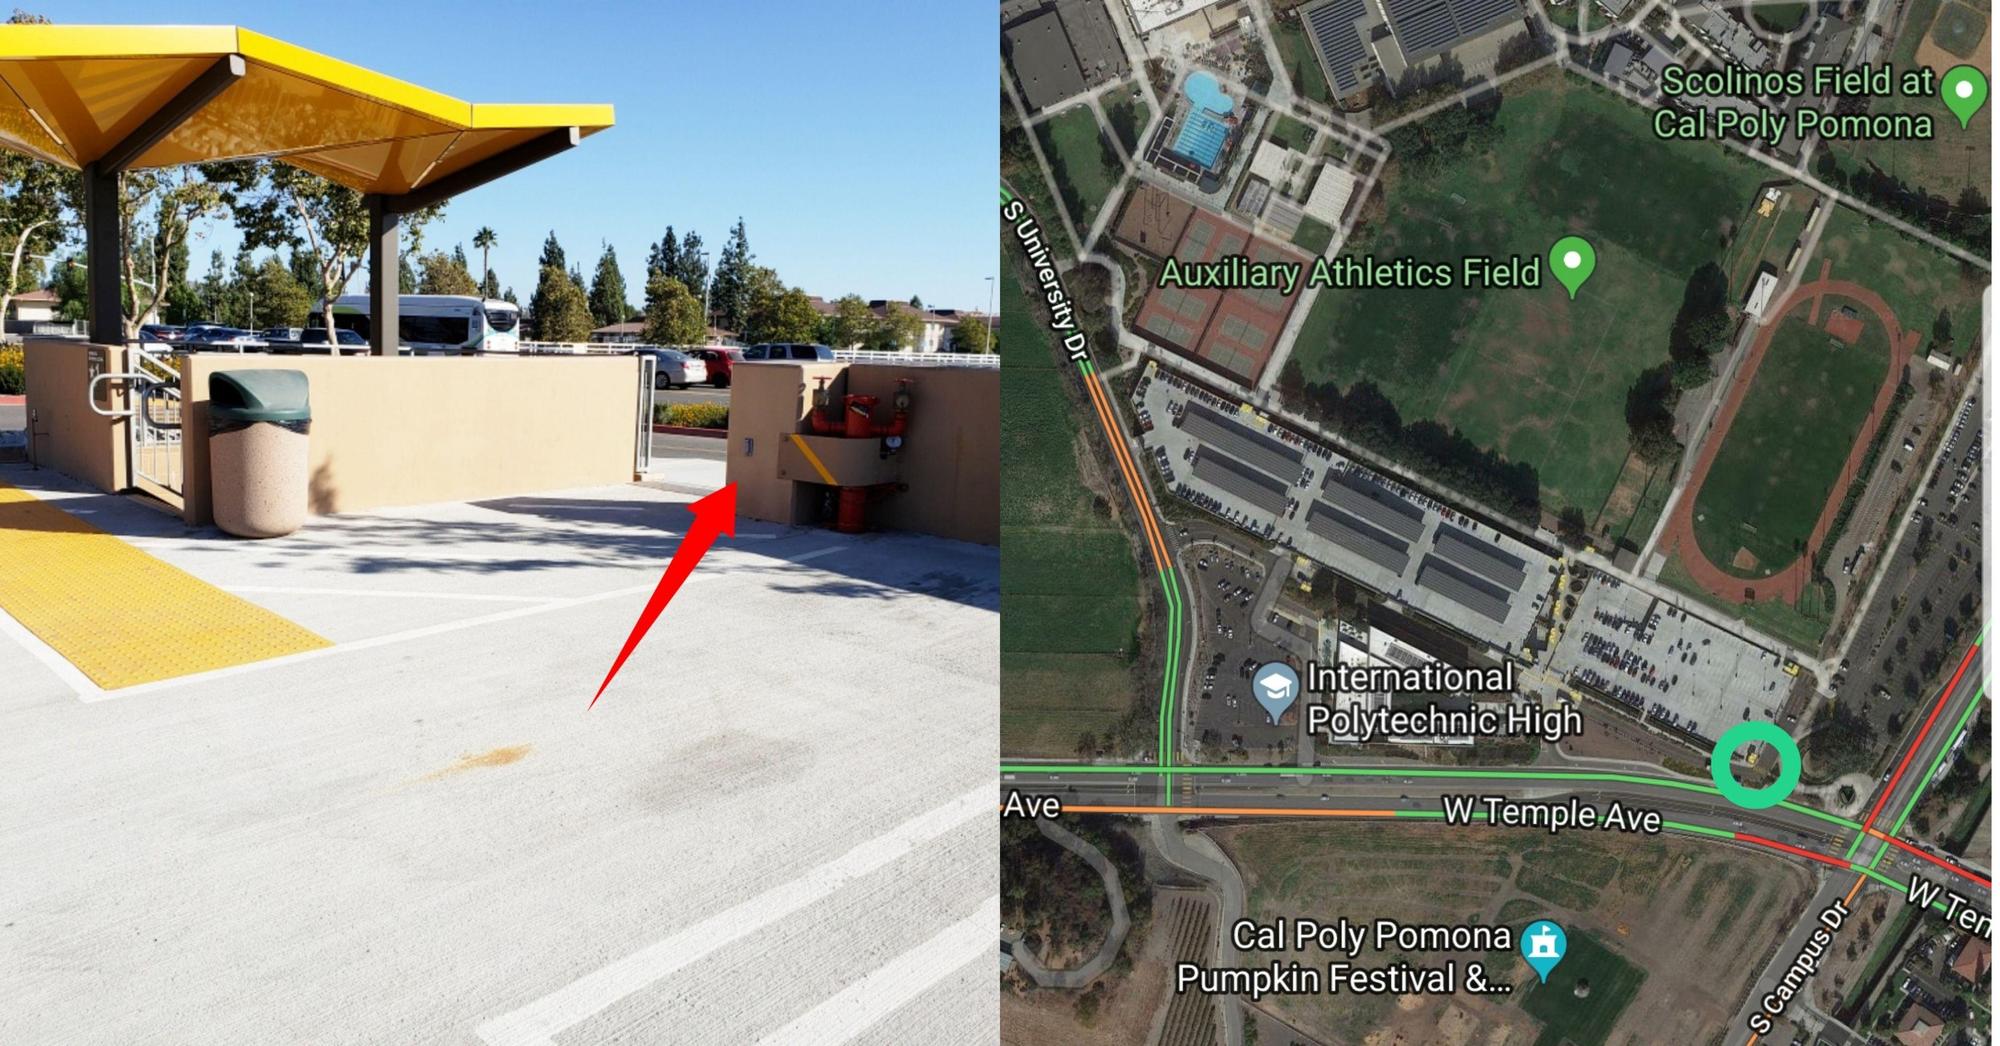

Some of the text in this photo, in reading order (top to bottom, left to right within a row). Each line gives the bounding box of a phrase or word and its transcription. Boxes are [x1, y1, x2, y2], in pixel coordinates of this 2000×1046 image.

[1663, 65, 1933, 95] Scolinos Field at
[1655, 108, 1932, 145] Cal Poly Pomona
[1004, 201, 1088, 360] S University Dr
[1159, 257, 1540, 293] Auxiliary Athletics Field
[1309, 662, 1513, 690] International
[1309, 705, 1582, 739] Polytechnic High
[1003, 791, 1060, 818] Ave
[1444, 797, 1661, 832] W Temple Ave
[1909, 876, 1940, 908] W
[1233, 920, 1511, 957] Cal Poly Pomona
[1178, 964, 1319, 998] Pumpkin
[1331, 964, 1454, 992] Festival
[1750, 901, 1848, 1034] S Campus Dr
